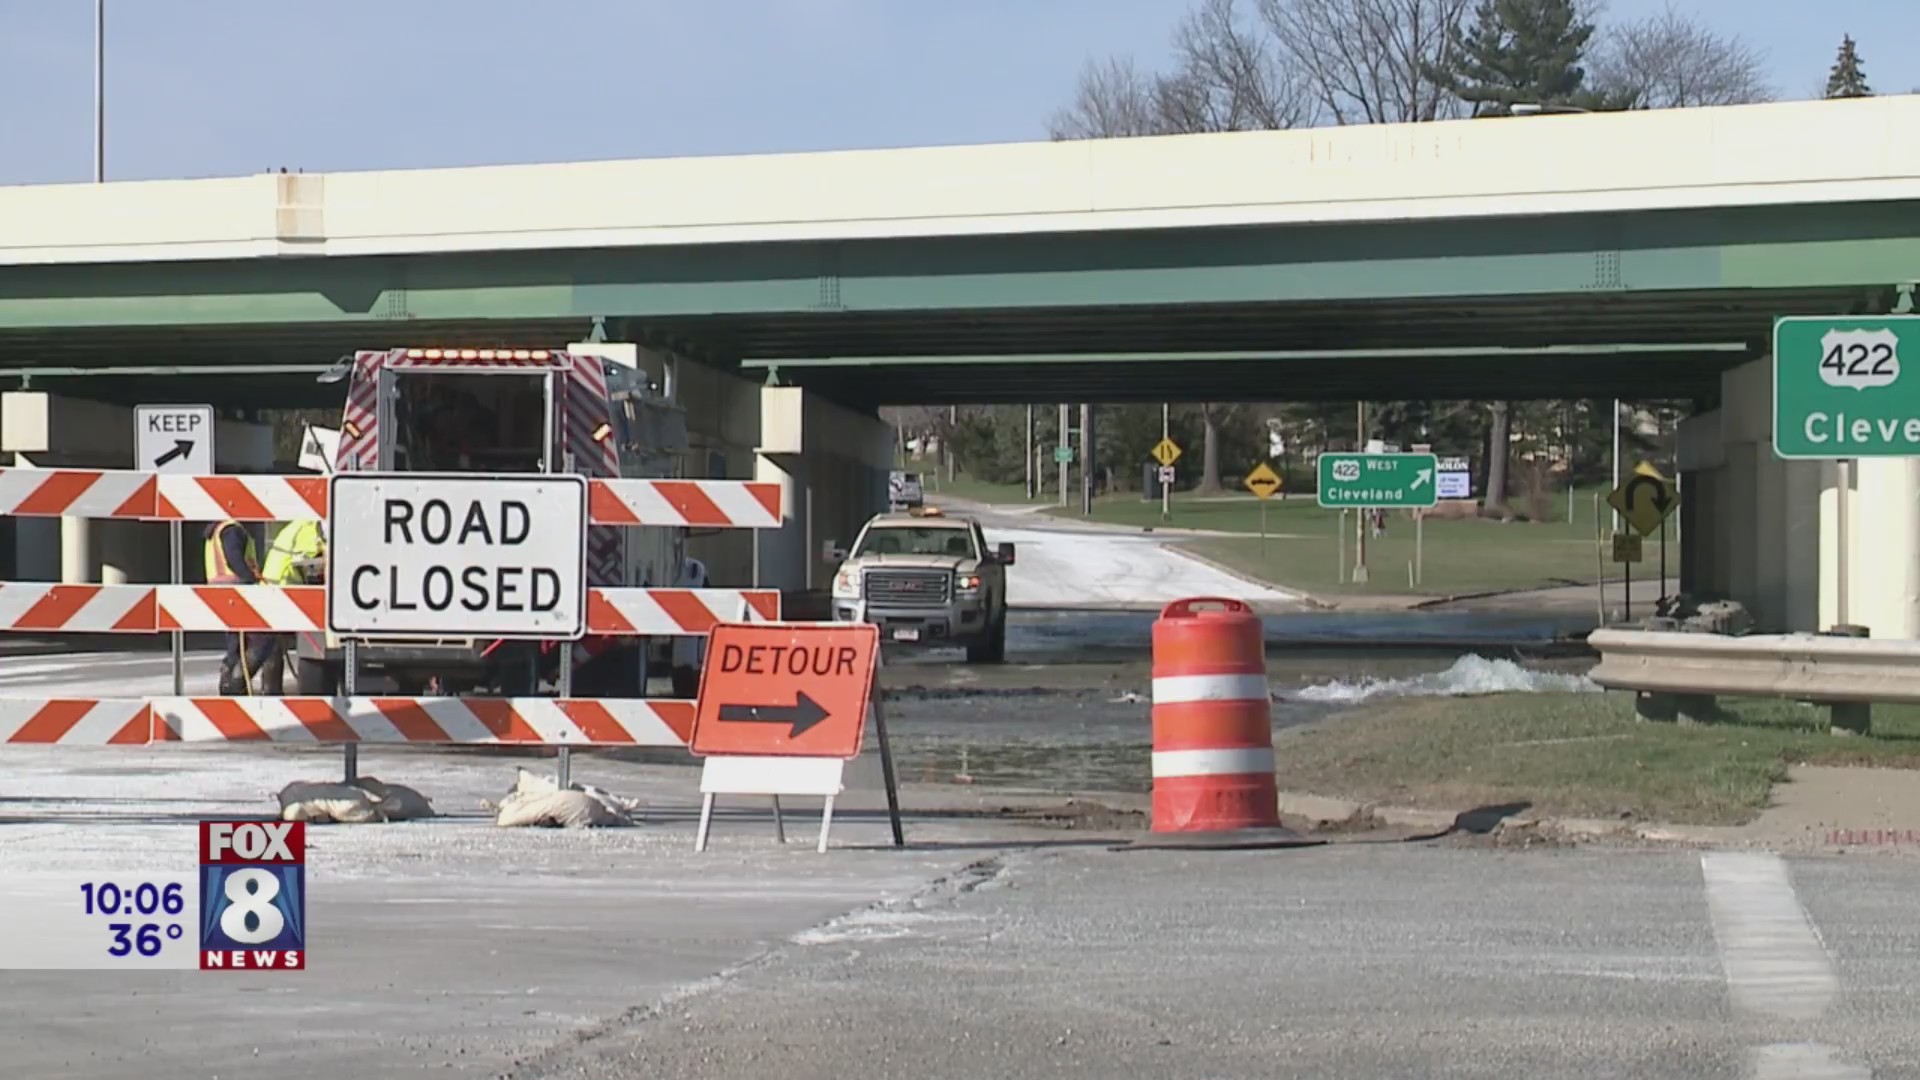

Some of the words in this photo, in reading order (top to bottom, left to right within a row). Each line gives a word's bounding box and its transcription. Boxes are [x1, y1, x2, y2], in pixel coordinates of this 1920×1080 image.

[1822, 343, 1894, 376] 422
[148, 414, 201, 432] KEEP
[1804, 411, 1920, 443] Cleve
[1334, 464, 1358, 477] 422
[1366, 460, 1398, 470] WEST
[1328, 487, 1403, 500] Cleveland
[384, 499, 531, 545] ROAD
[351, 565, 561, 611] CLOSED
[721, 644, 857, 676] DETOUR
